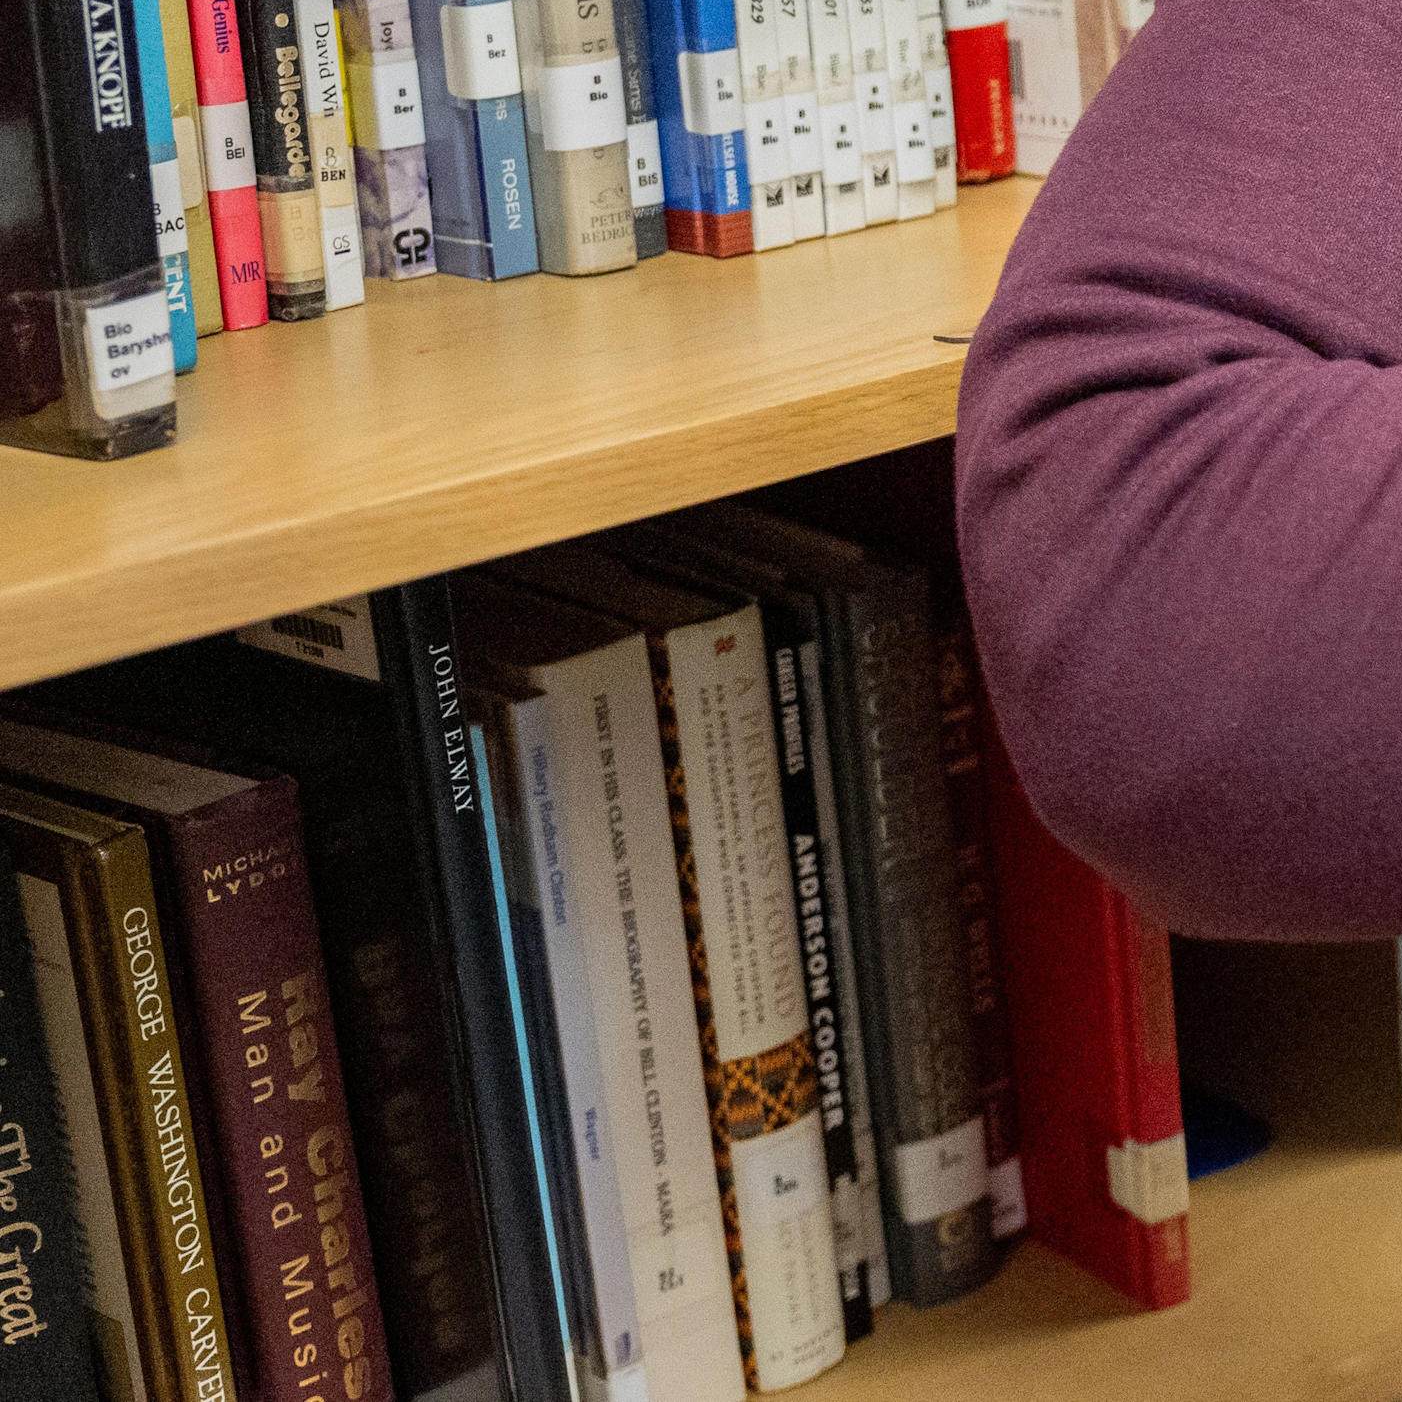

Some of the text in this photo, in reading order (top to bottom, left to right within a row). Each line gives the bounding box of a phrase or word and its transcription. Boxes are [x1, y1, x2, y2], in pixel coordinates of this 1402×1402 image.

[94, 30, 127, 129] KNOPF
[313, 20, 334, 80] David
[224, 137, 234, 148] B
[226, 147, 246, 160] BEI
[274, 45, 311, 180] Bellegarde
[320, 168, 347, 183] BEN
[500, 157, 522, 231] ROSEN
[103, 322, 133, 340] Bio
[428, 643, 475, 814] JOHN ELWAY
[793, 834, 844, 1131] ANDERSON COOPER
[122, 905, 205, 1275] GEORGE WASHINGTON
[236, 990, 303, 1230] Man and
[306, 1124, 371, 1401] Charles
